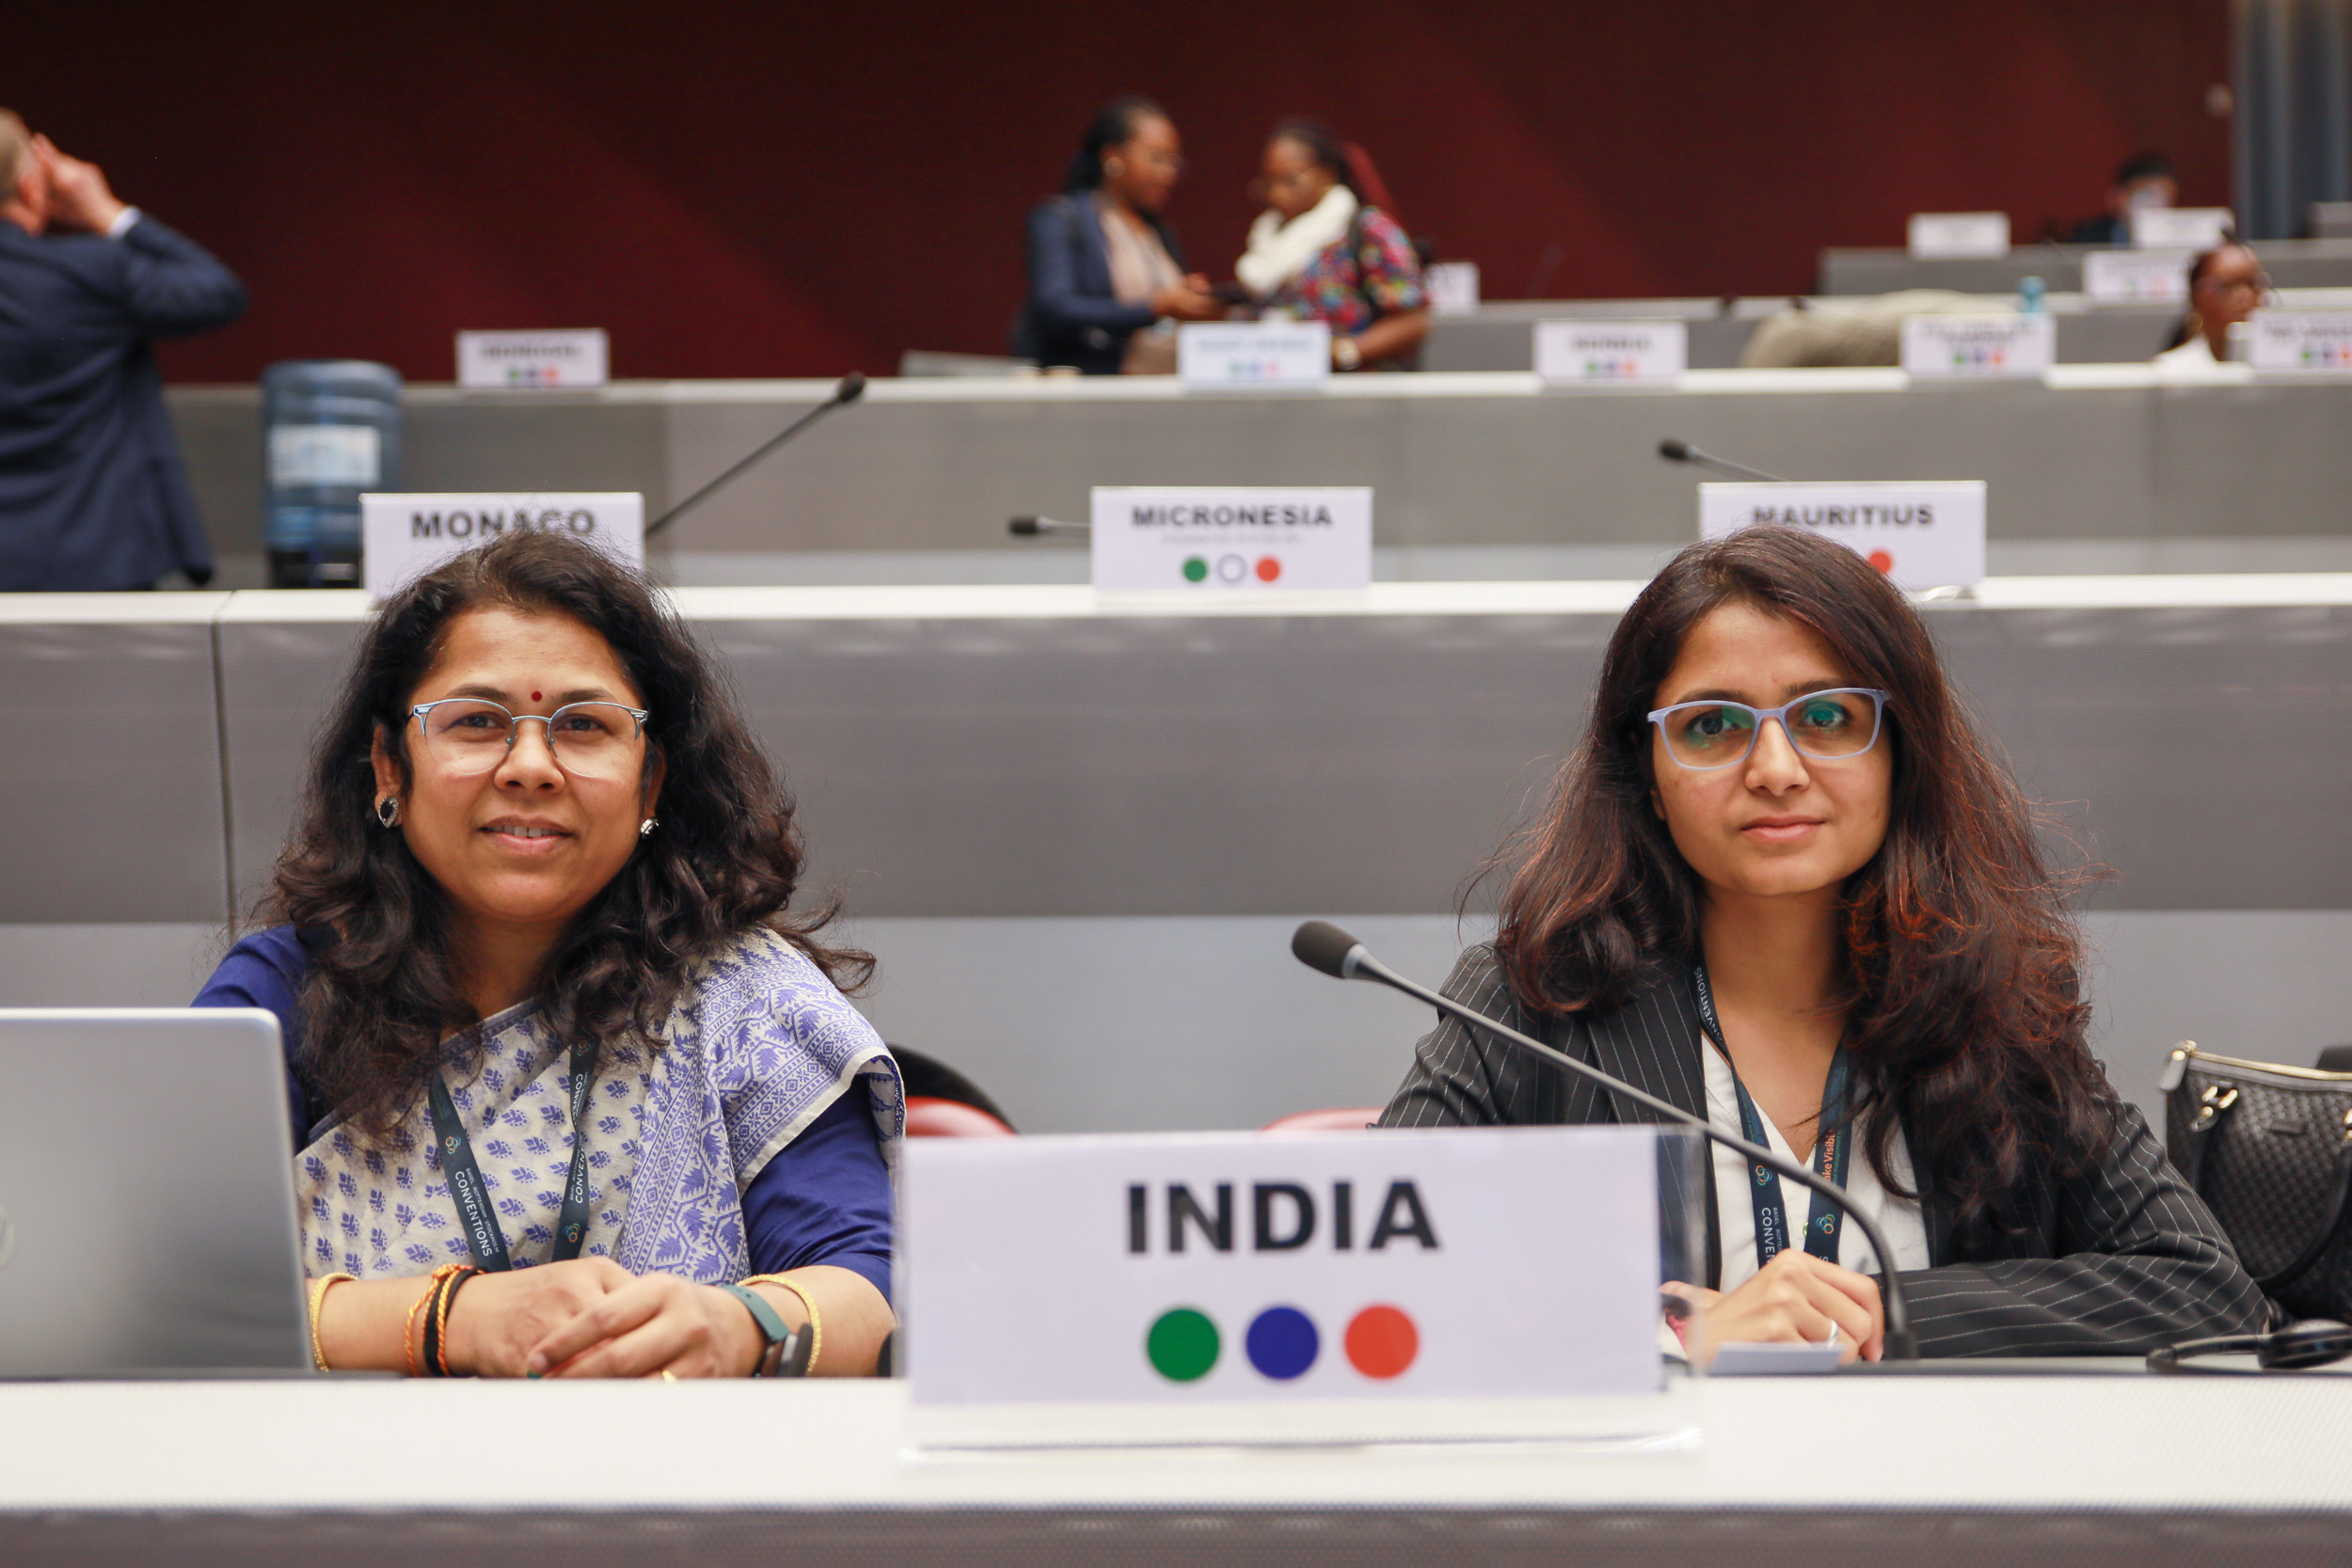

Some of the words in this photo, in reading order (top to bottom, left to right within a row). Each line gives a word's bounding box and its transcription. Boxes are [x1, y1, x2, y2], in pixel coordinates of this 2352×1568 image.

[411, 510, 595, 538] MONACO
[1131, 505, 1332, 527] MICRONESIA
[1754, 504, 1933, 526] MAURITIUS
[1821, 1163, 1833, 1182] ake
[454, 1170, 493, 1257] CONVENTIONS
[465, 1167, 475, 1185] BASEL
[472, 1186, 487, 1218] ROTTERDAM
[485, 1220, 500, 1253] STOCKHOLM
[1129, 1180, 1439, 1253] INDIA
